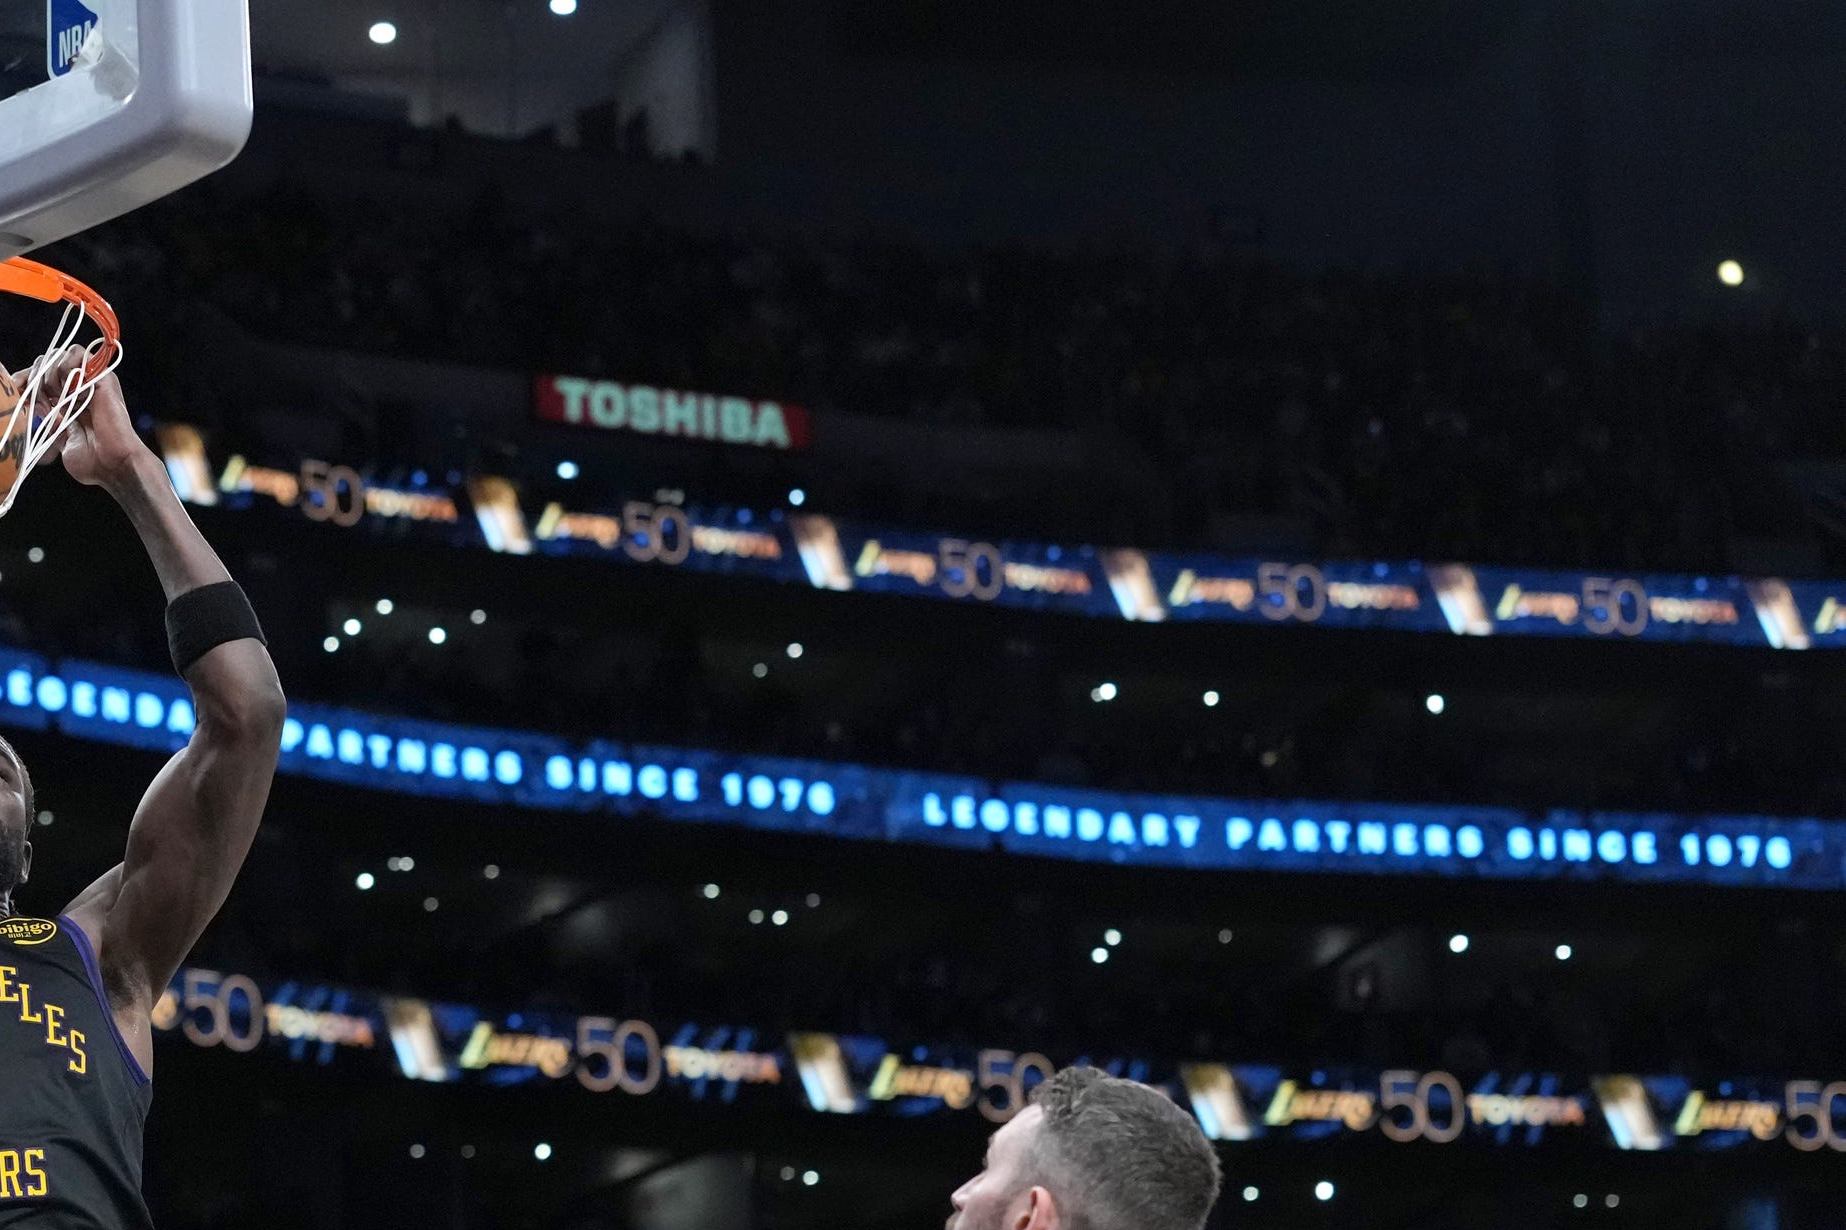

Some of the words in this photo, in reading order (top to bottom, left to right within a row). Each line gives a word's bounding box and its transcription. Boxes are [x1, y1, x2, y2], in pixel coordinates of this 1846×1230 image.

[554, 375, 791, 448] TOSHIBA
[280, 718, 522, 784] PARTNERS
[545, 755, 698, 802] SINCE
[922, 792, 1201, 849] LEGENDARY
[1226, 817, 1484, 858] PARTNERS
[1506, 827, 1657, 864] SINCE
[182, 967, 263, 1052] 50
[575, 1015, 661, 1095] 50
[977, 1046, 1056, 1124] 50
[1379, 1070, 1464, 1143] 50
[1785, 1080, 1846, 1152] 50
